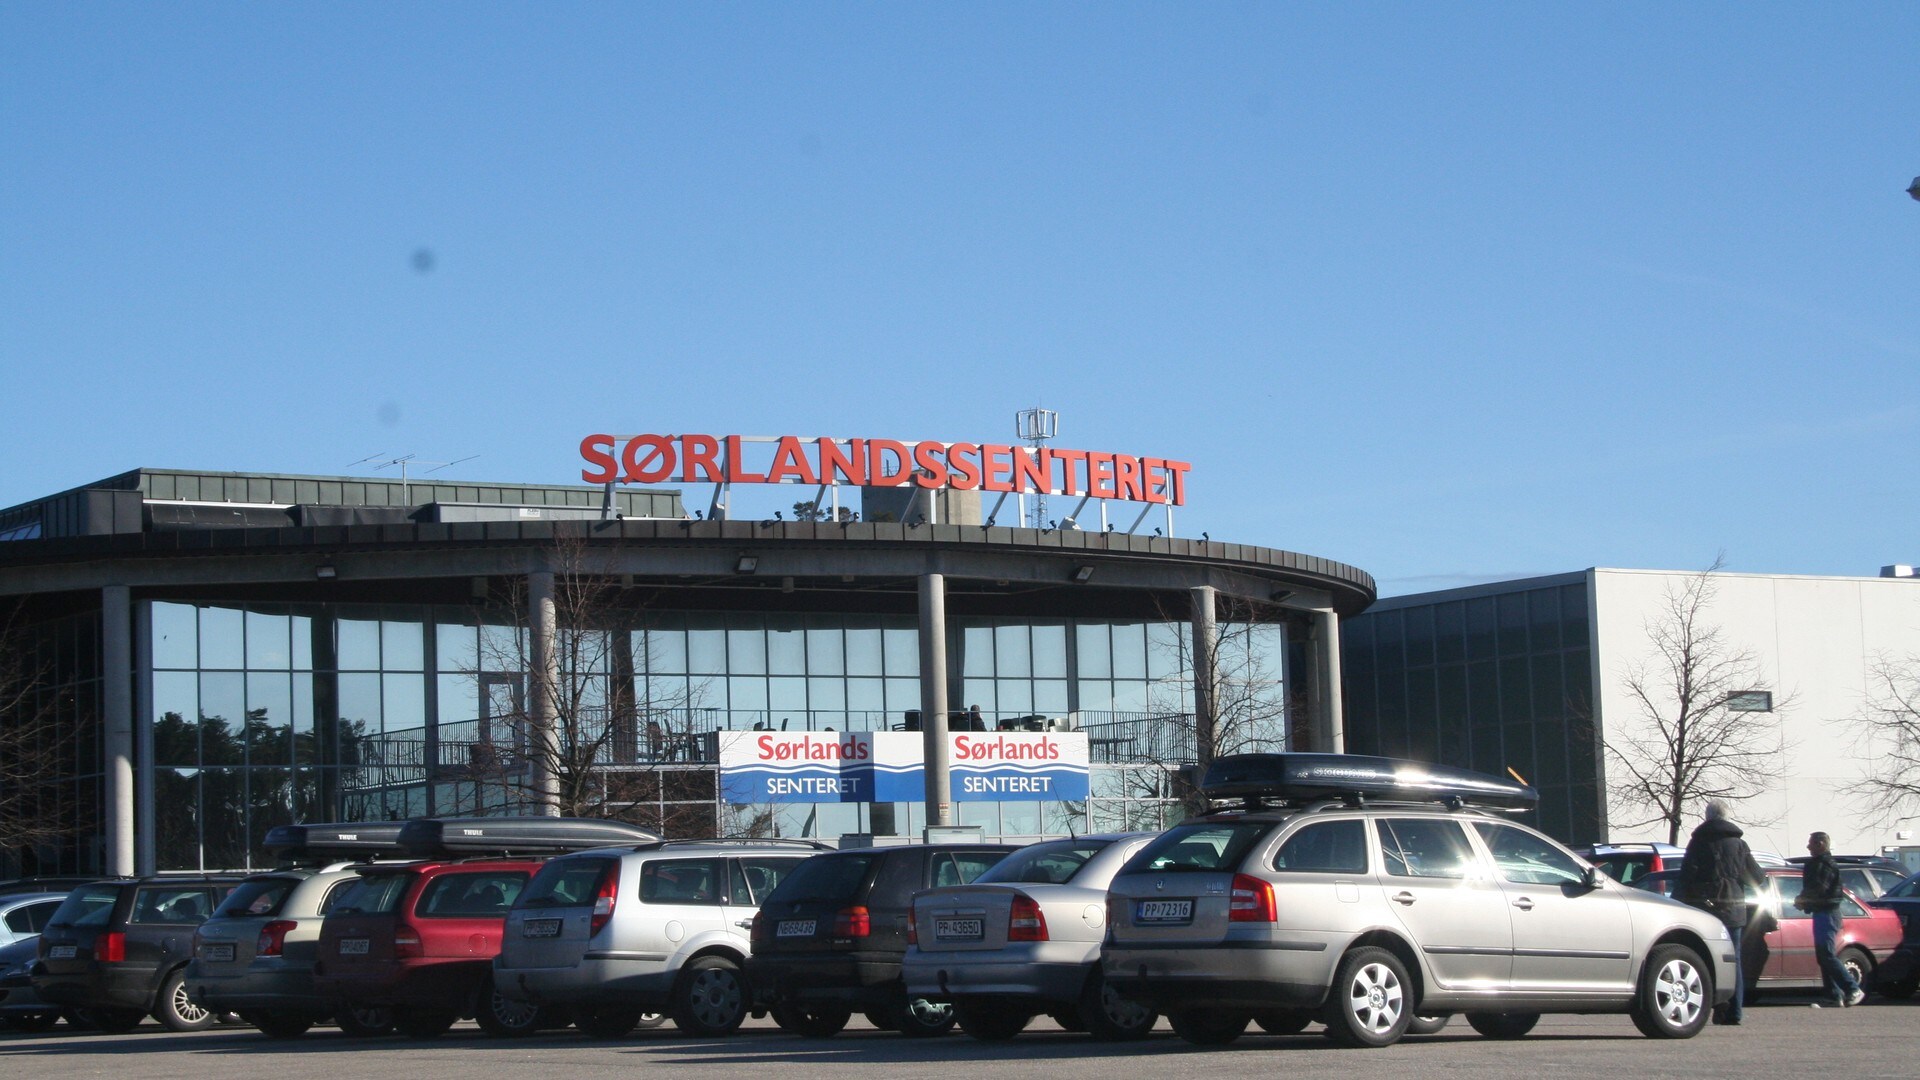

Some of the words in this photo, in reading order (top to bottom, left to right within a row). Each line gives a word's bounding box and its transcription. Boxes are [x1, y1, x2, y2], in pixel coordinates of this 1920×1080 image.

[580, 433, 1191, 506] SØRLANDSSENTERET
[757, 734, 869, 761] Sørlands
[955, 735, 1059, 761] Sørlands
[767, 777, 861, 794] SENTERET
[963, 776, 1052, 793] SENTERET
